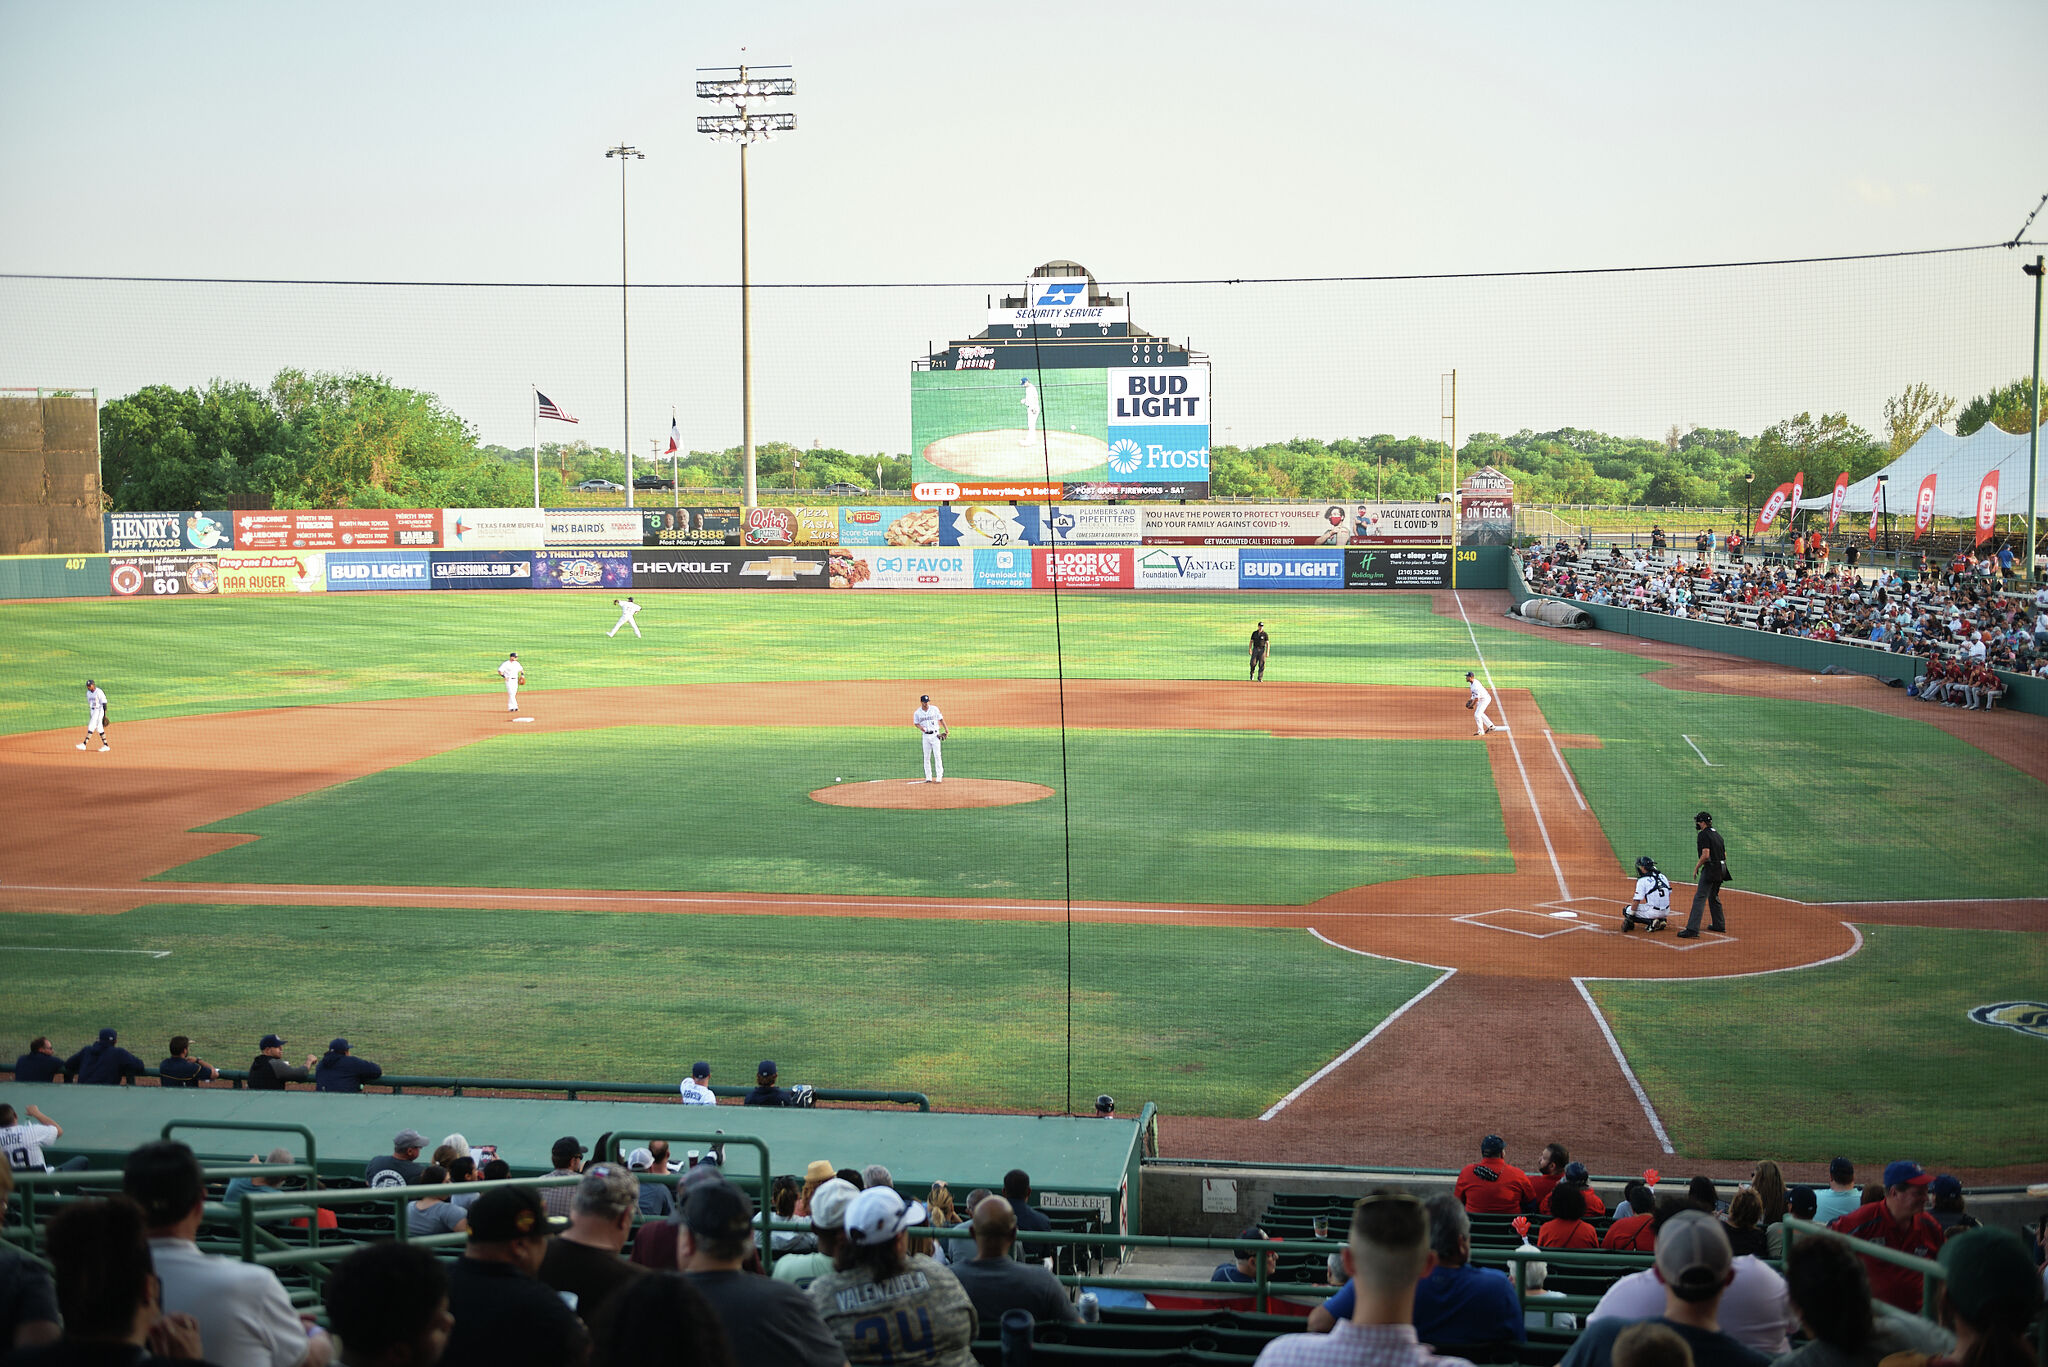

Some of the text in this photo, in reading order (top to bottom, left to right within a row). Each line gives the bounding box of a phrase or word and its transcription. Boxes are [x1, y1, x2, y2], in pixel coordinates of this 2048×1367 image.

[1015, 308, 1103, 319] SECURITY SERVICE
[1016, 329, 1023, 338] 0
[1056, 328, 1063, 337] 0
[1101, 327, 1108, 336] 0
[1128, 375, 1188, 396] BUD
[1117, 397, 1200, 418] LIGHT
[1146, 444, 1209, 469] Frost
[1280, 510, 1320, 518] YOURSELF
[1380, 508, 1452, 518] VACÚNATE CONTRA
[1466, 507, 1511, 519] ON DECK.
[650, 513, 662, 528] 8
[1080, 515, 1135, 524] PIPEFITTERS
[1187, 520, 1215, 528] FAMILY
[1216, 520, 1250, 528] AGAINST
[1393, 519, 1438, 529] EL COVID-19
[111, 518, 181, 540] HENRY'S
[551, 523, 605, 533] MRS BAIRD'S
[841, 529, 882, 537] Score Some
[659, 529, 726, 540] 888-8888
[991, 533, 1009, 546] 20
[112, 539, 181, 549] PUFFY TACOS
[677, 539, 698, 547] Money
[536, 551, 547, 559] 30
[549, 551, 596, 559] THRILLING
[1046, 553, 1097, 564] FLOOR
[1407, 552, 1424, 560] sleep
[1431, 552, 1447, 561] play
[1457, 550, 1477, 561] 340
[65, 558, 87, 569] 407
[220, 557, 297, 570] Drop one in here!
[632, 562, 732, 573] CHEVROLET
[907, 558, 963, 572] FAVOR
[1171, 555, 1236, 578] VANTAGE
[331, 563, 424, 579] BUD LIGHT
[584, 570, 601, 579] Flags
[1019, 571, 1032, 579] the
[1046, 564, 1097, 575] DECOR
[1142, 570, 1178, 579] Foundation
[1244, 562, 1339, 577] BUD LIGHT
[1186, 571, 1206, 582] Repair
[1351, 572, 1374, 580] Holiday
[153, 578, 179, 594] 60
[223, 576, 286, 588] AAA AUGER
[1010, 580, 1024, 588] app
[1043, 1196, 1081, 1208] PLEASE
[836, 1271, 930, 1312] VALENZUELA
